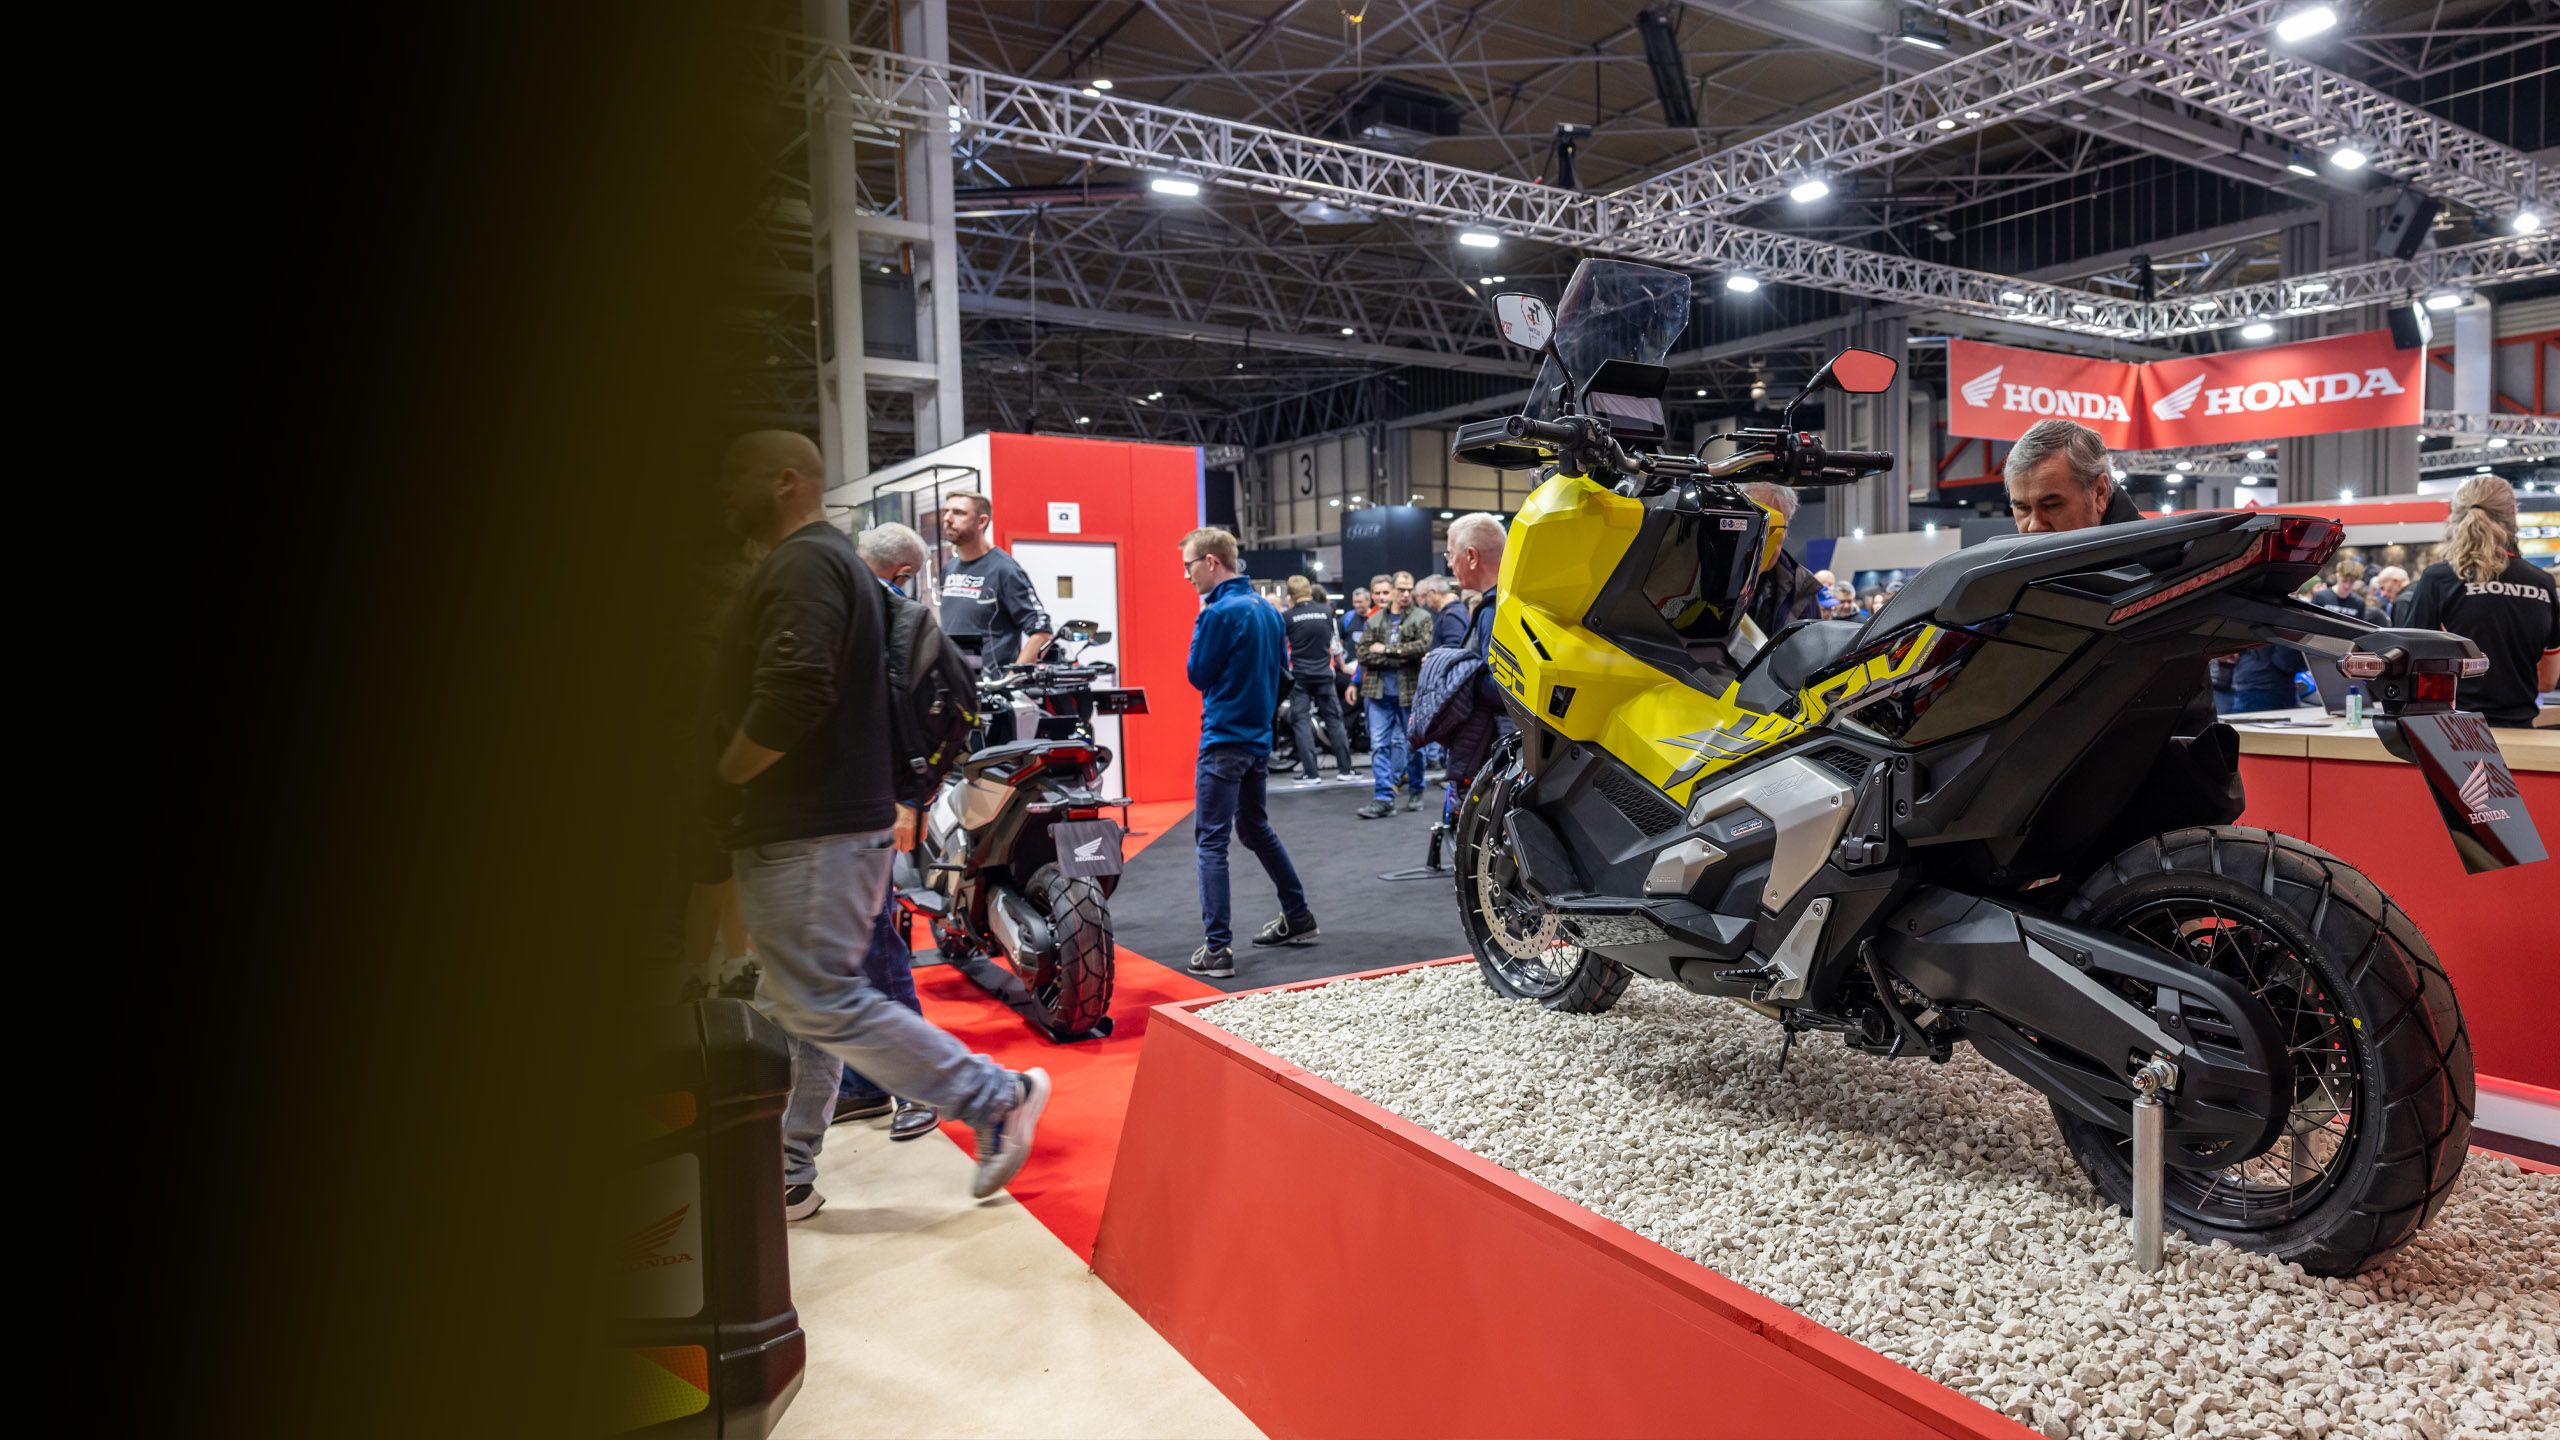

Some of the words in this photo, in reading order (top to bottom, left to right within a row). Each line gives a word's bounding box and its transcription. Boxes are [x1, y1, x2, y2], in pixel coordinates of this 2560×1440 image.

[2002, 383, 2132, 422] HONDA
[2204, 367, 2405, 417] HONDA
[1300, 453, 1312, 495] 3
[2464, 581, 2551, 603] HONDA
[1292, 612, 1327, 623] HONDA
[2468, 809, 2510, 824] HONDA
[1074, 854, 1106, 862] HONDA
